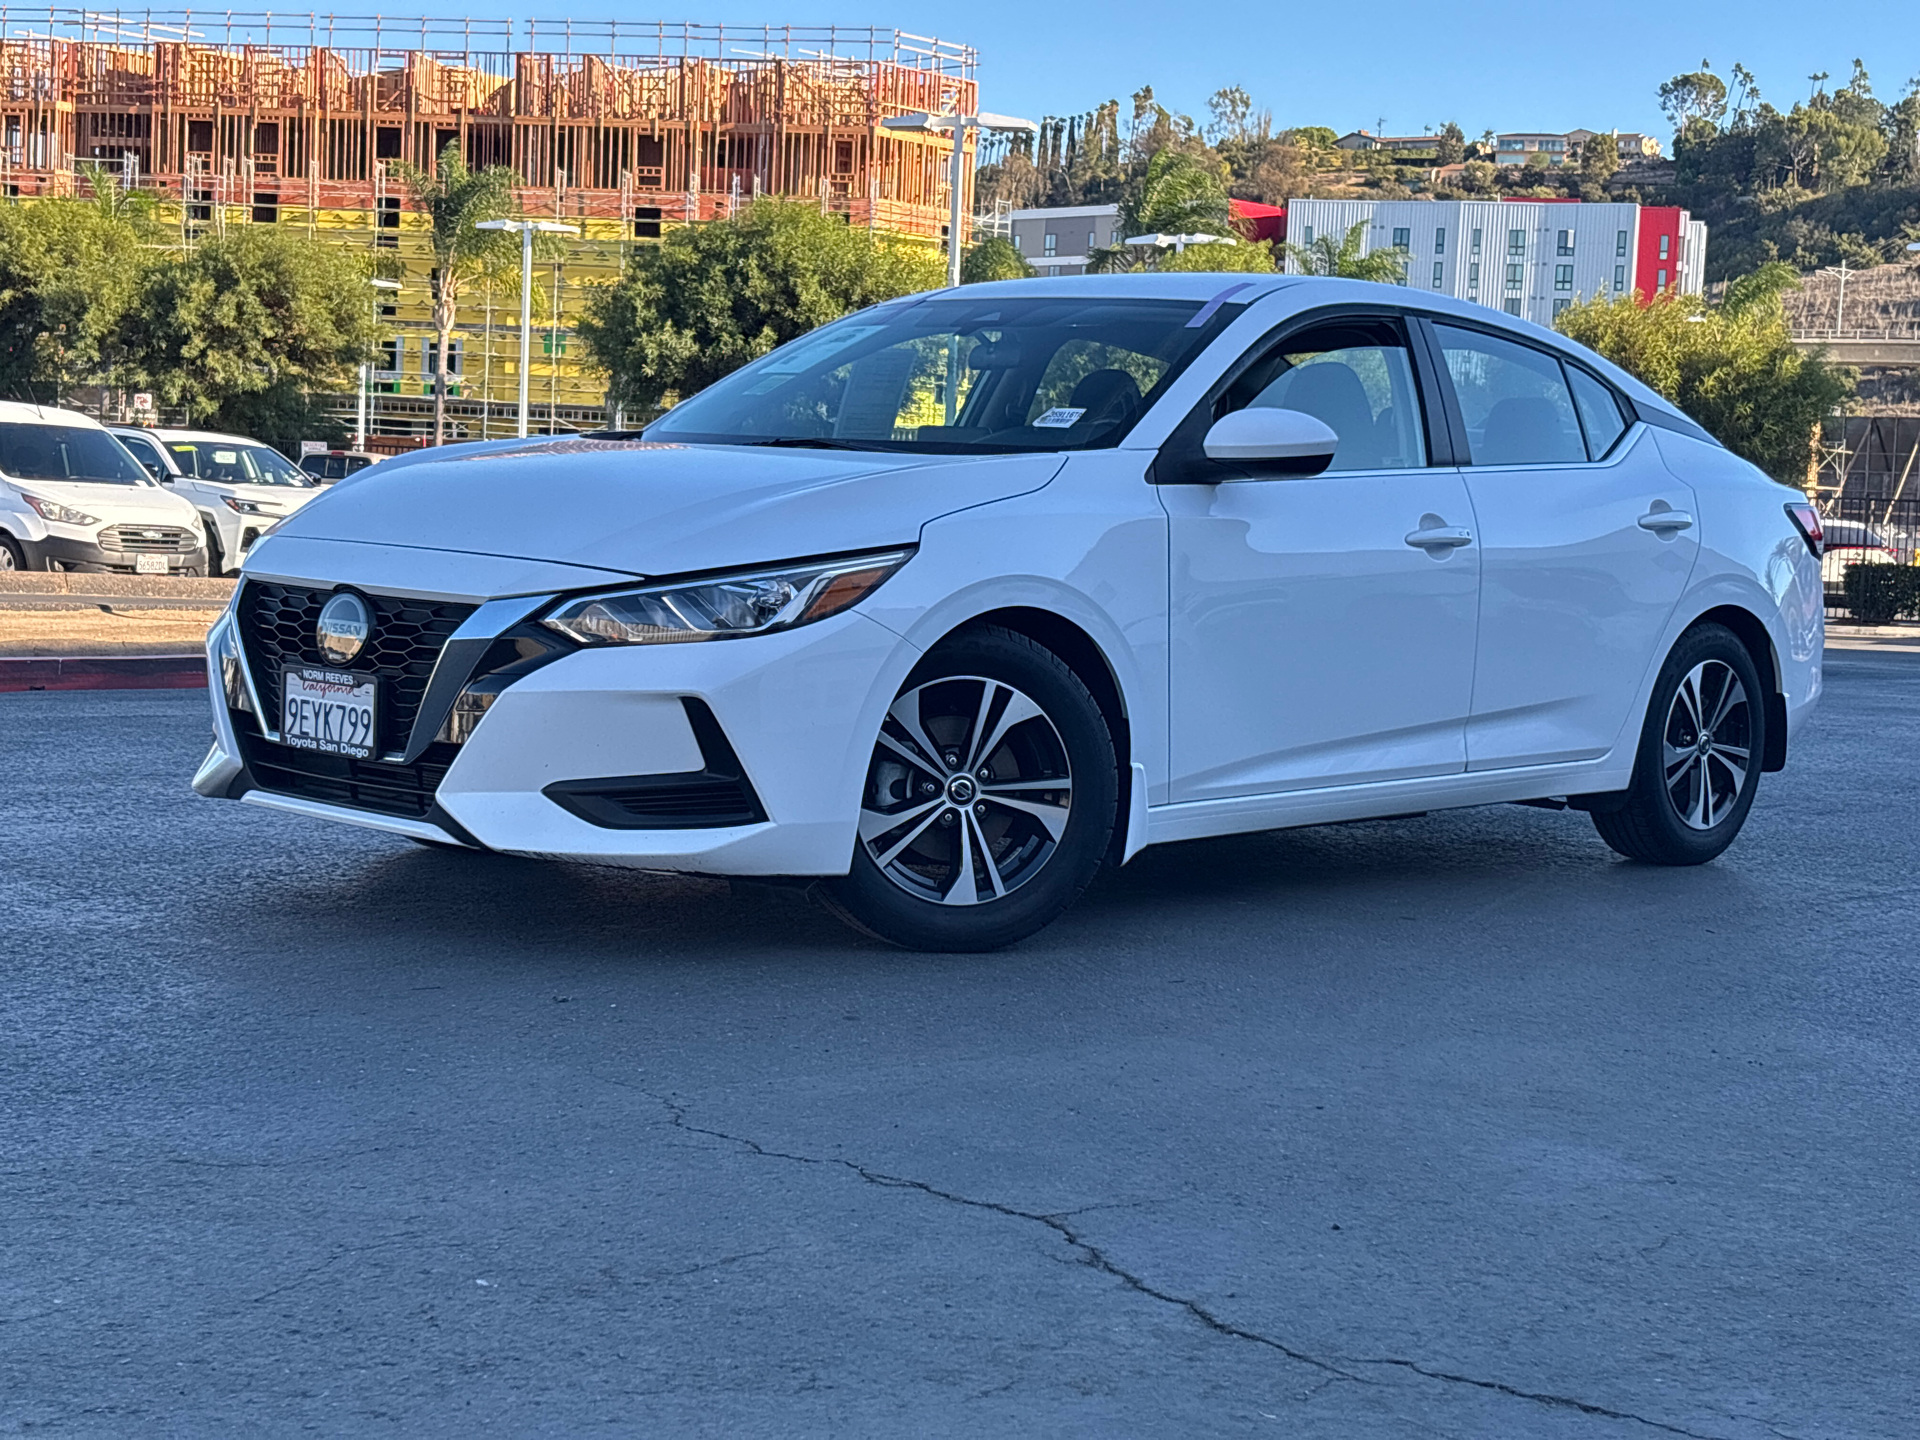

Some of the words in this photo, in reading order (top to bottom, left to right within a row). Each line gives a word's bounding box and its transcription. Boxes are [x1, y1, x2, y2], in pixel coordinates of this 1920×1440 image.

[324, 621, 361, 636] NISSAN
[302, 669, 324, 681] NORM
[325, 672, 354, 685] REEVES
[288, 697, 371, 746] 9EYK799
[285, 734, 317, 748] Toyota
[319, 739, 338, 752] San
[340, 743, 369, 758] Diego
